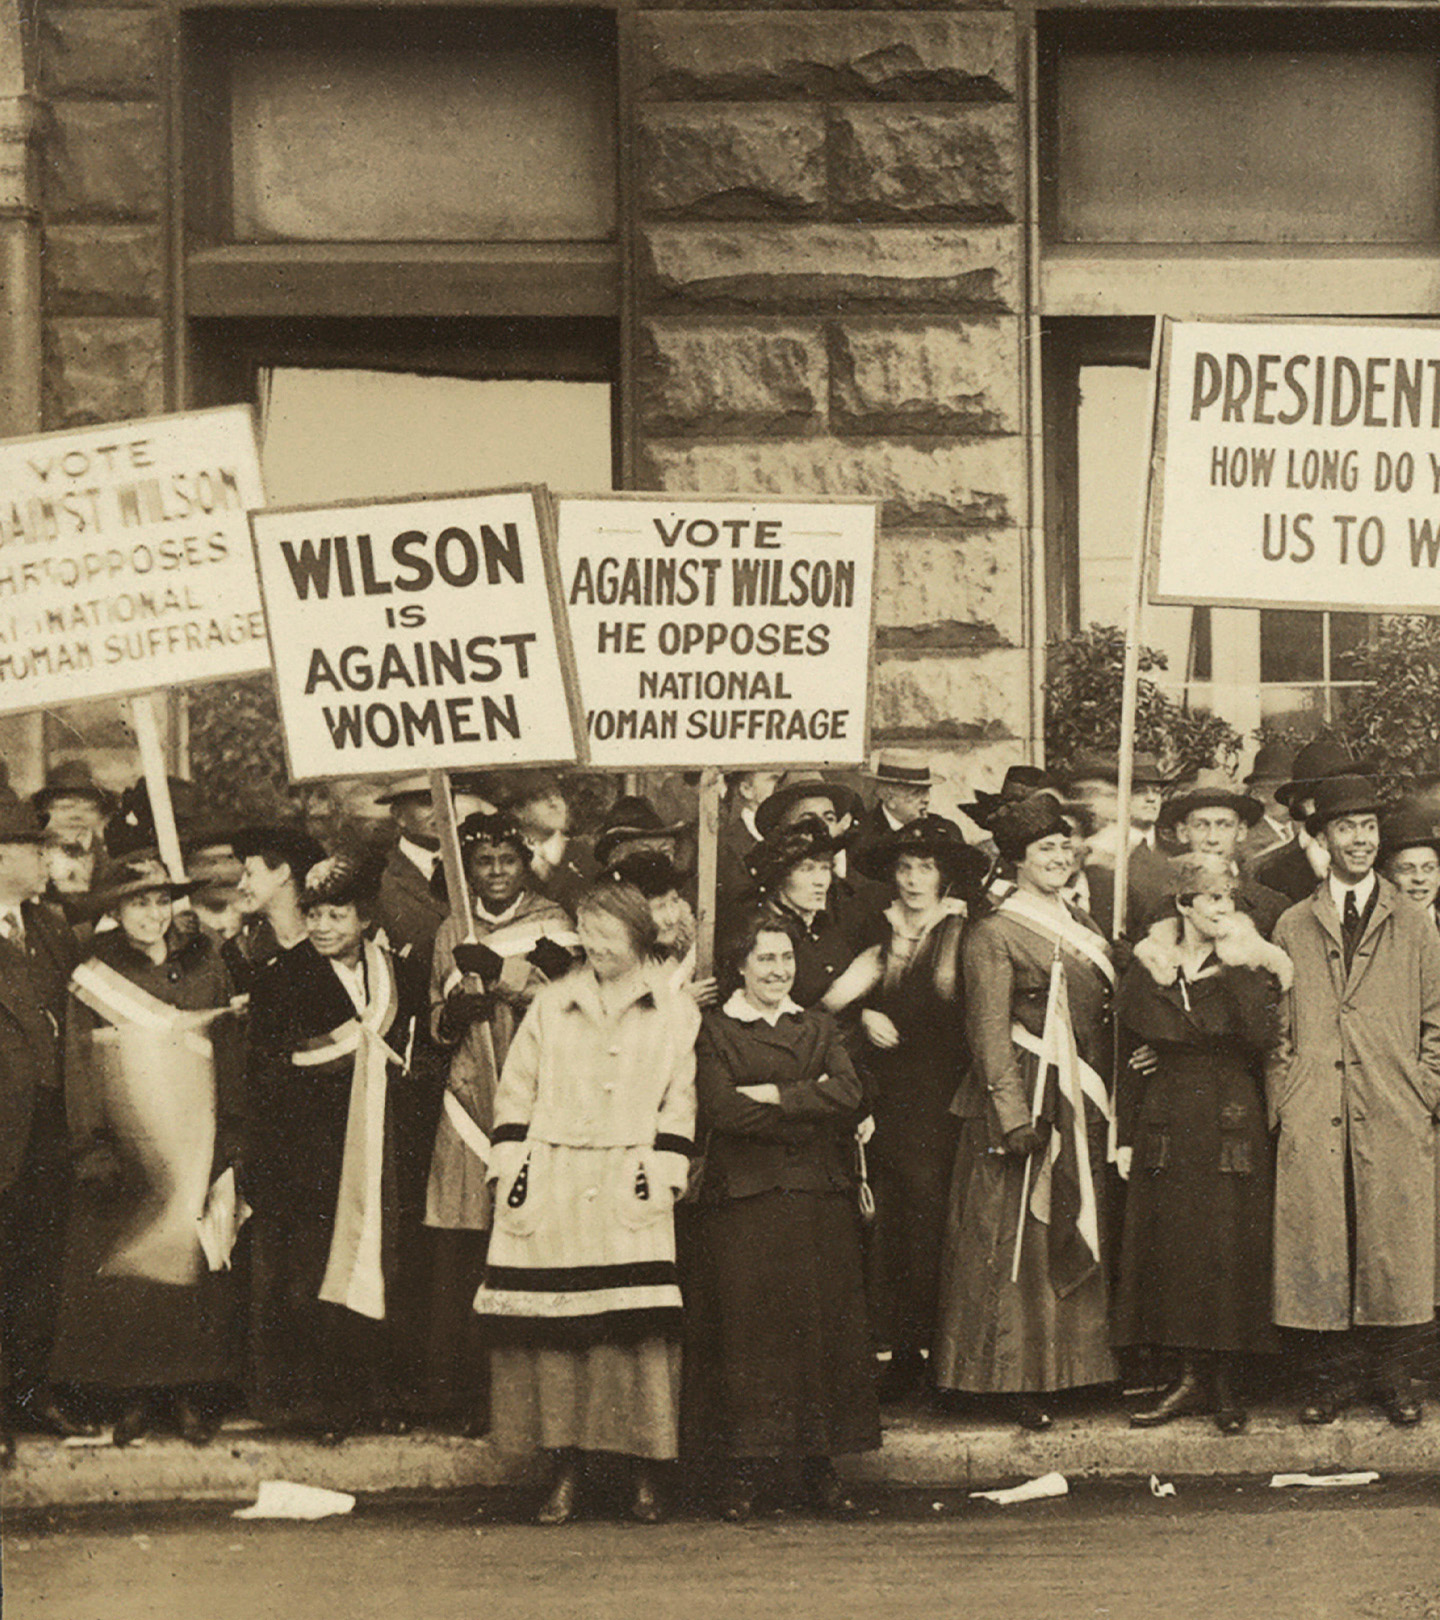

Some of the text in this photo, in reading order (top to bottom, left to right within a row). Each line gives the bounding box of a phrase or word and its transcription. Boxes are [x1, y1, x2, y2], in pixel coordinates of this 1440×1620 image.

[27, 439, 154, 483] VOTE
[1210, 446, 1276, 488] HOW
[1286, 449, 1358, 492] LONG
[1374, 451, 1415, 493] DO
[653, 518, 783, 549] VOTE
[1262, 513, 1315, 564] US
[1333, 515, 1385, 567] TO
[279, 522, 524, 601] WILSON
[569, 556, 855, 608] AGAINST WILSON
[104, 610, 265, 664] SUFFRAGE
[385, 604, 427, 629] IS
[598, 621, 830, 656] HE OPPOSES
[304, 632, 537, 695] AGAINST
[639, 670, 792, 701] NATIONAL
[322, 693, 522, 751] WOMEN
[588, 708, 849, 740] OMAN SUFFRAGE
